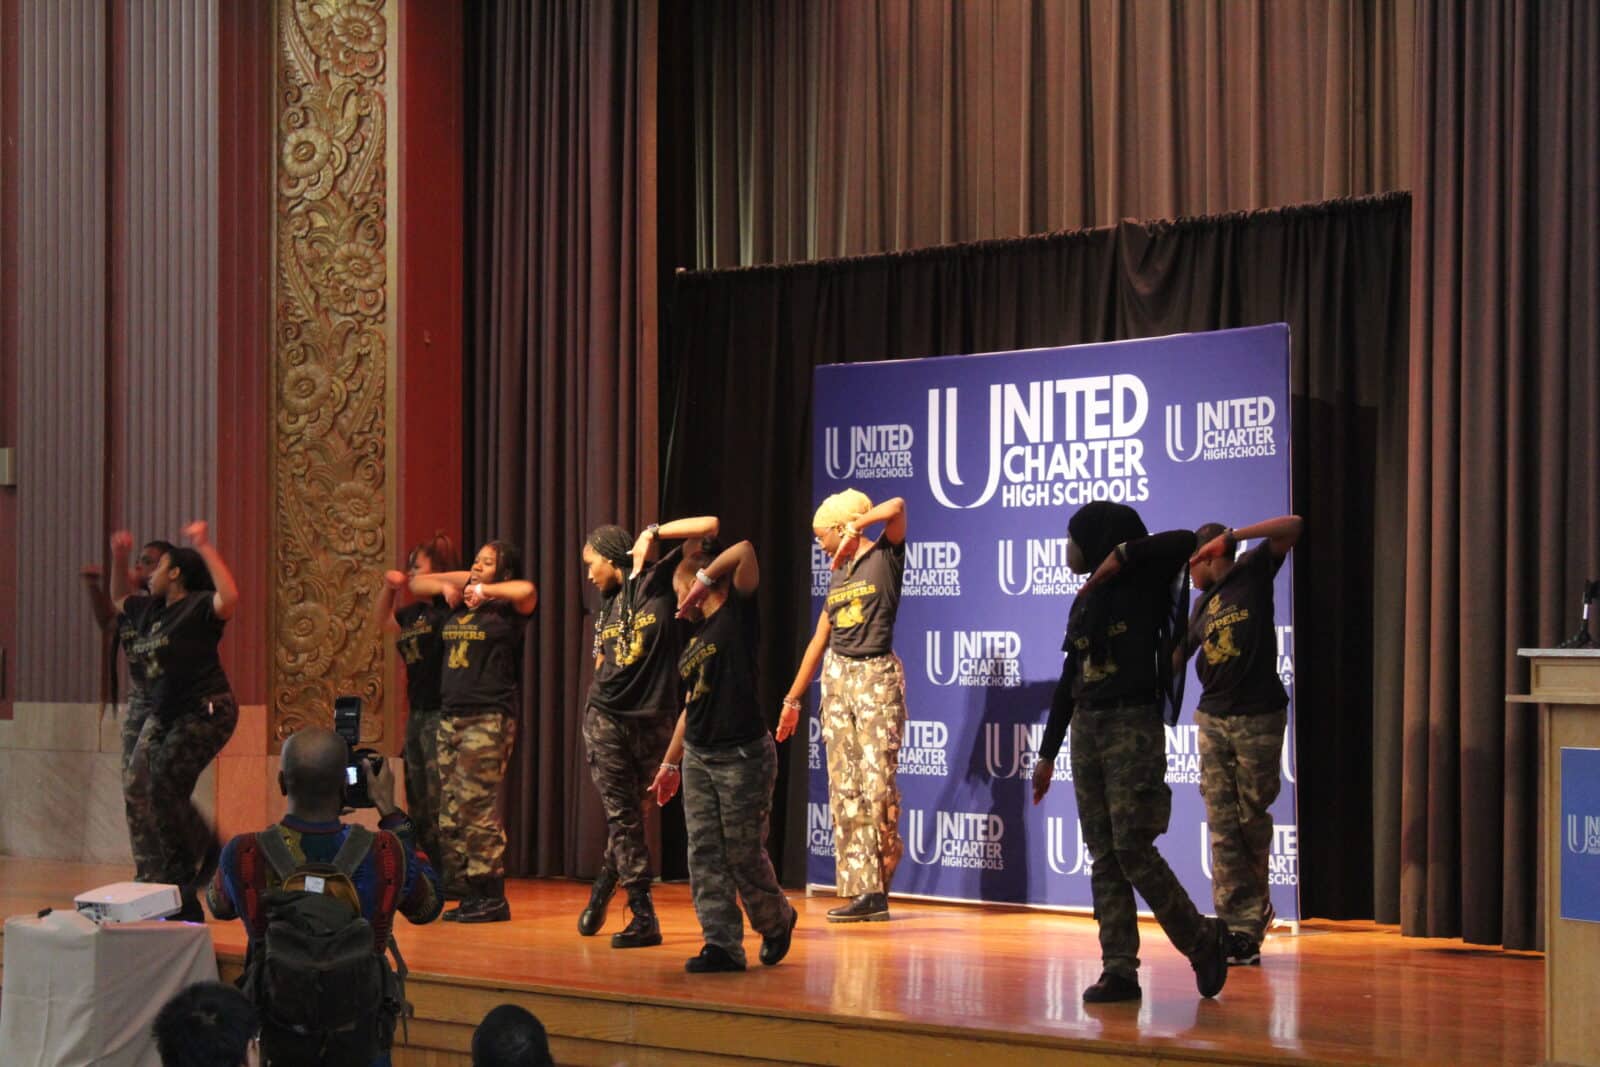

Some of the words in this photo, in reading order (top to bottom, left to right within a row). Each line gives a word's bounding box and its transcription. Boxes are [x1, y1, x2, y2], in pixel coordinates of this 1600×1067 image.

[1165, 395, 1276, 462] UNITED
[1204, 426, 1275, 448] CHARTER
[927, 373, 1149, 509] UNITED
[825, 424, 914, 480] UNITED
[856, 451, 913, 468] CHARTER
[1003, 438, 1147, 484] CHARTER
[1203, 448, 1228, 461] HIGH
[1228, 443, 1277, 459] SCHOOLS
[855, 467, 876, 479] HIGH
[875, 466, 914, 479] SCHOOLS
[1002, 482, 1051, 508] HIGH
[1052, 477, 1150, 506] SCHOOLS
[904, 541, 962, 569] NITED
[998, 538, 1069, 595] UNIT
[1033, 566, 1092, 585] CHARTE
[902, 569, 960, 586] CHARTER
[901, 585, 921, 597] HIGH
[922, 585, 961, 597] SCHOOLS
[1032, 583, 1055, 596] HIGH
[1055, 583, 1084, 596] SCHO
[926, 630, 1021, 686] UNITED
[959, 658, 1020, 676] CHARTER
[959, 675, 980, 687] HIGH
[981, 676, 1021, 688] SCHOOLS
[901, 719, 949, 748] ITED
[897, 747, 947, 765] HARTER
[908, 765, 949, 777] SCHOOLS
[909, 809, 1005, 865] UNITED
[942, 839, 1003, 859] CHARTER
[941, 855, 962, 868] HIGH
[962, 856, 1004, 871] SCHOOLS
[1268, 873, 1298, 886] SCHO
